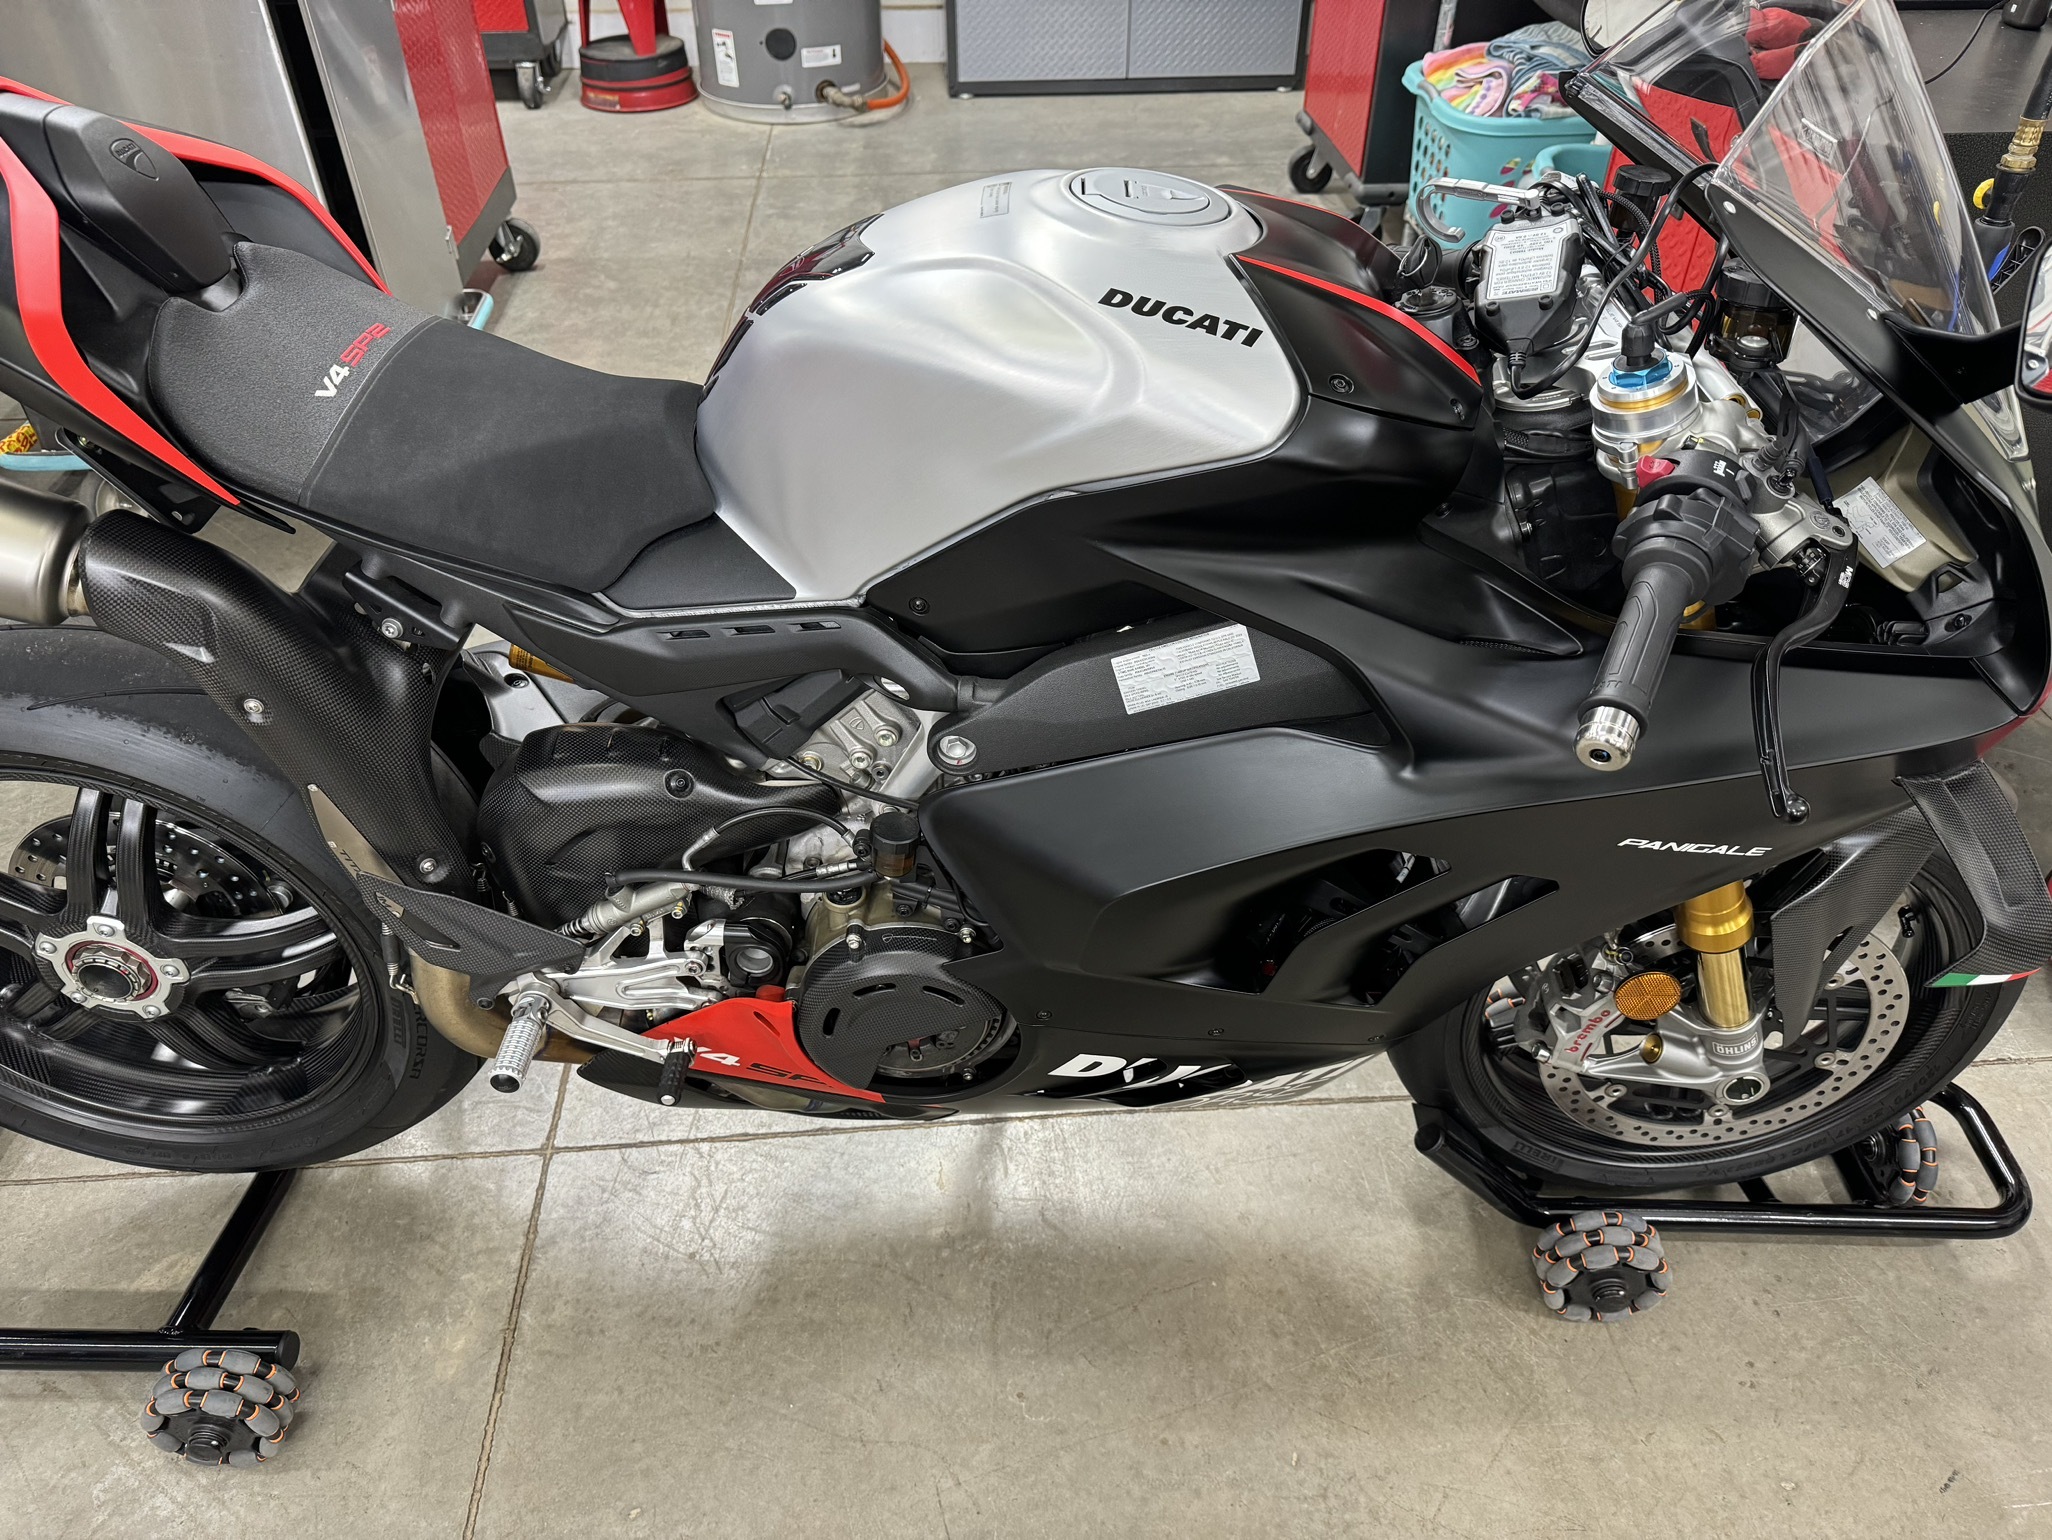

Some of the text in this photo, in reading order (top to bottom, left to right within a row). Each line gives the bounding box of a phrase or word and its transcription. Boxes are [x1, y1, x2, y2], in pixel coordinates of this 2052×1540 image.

[1098, 288, 1263, 347] DUCATI
[314, 323, 391, 397] V4 SP2
[1617, 838, 1773, 856] PANIGALE
[1564, 1009, 1611, 1053] brembo
[1716, 1036, 1758, 1055] ÖHLINS
